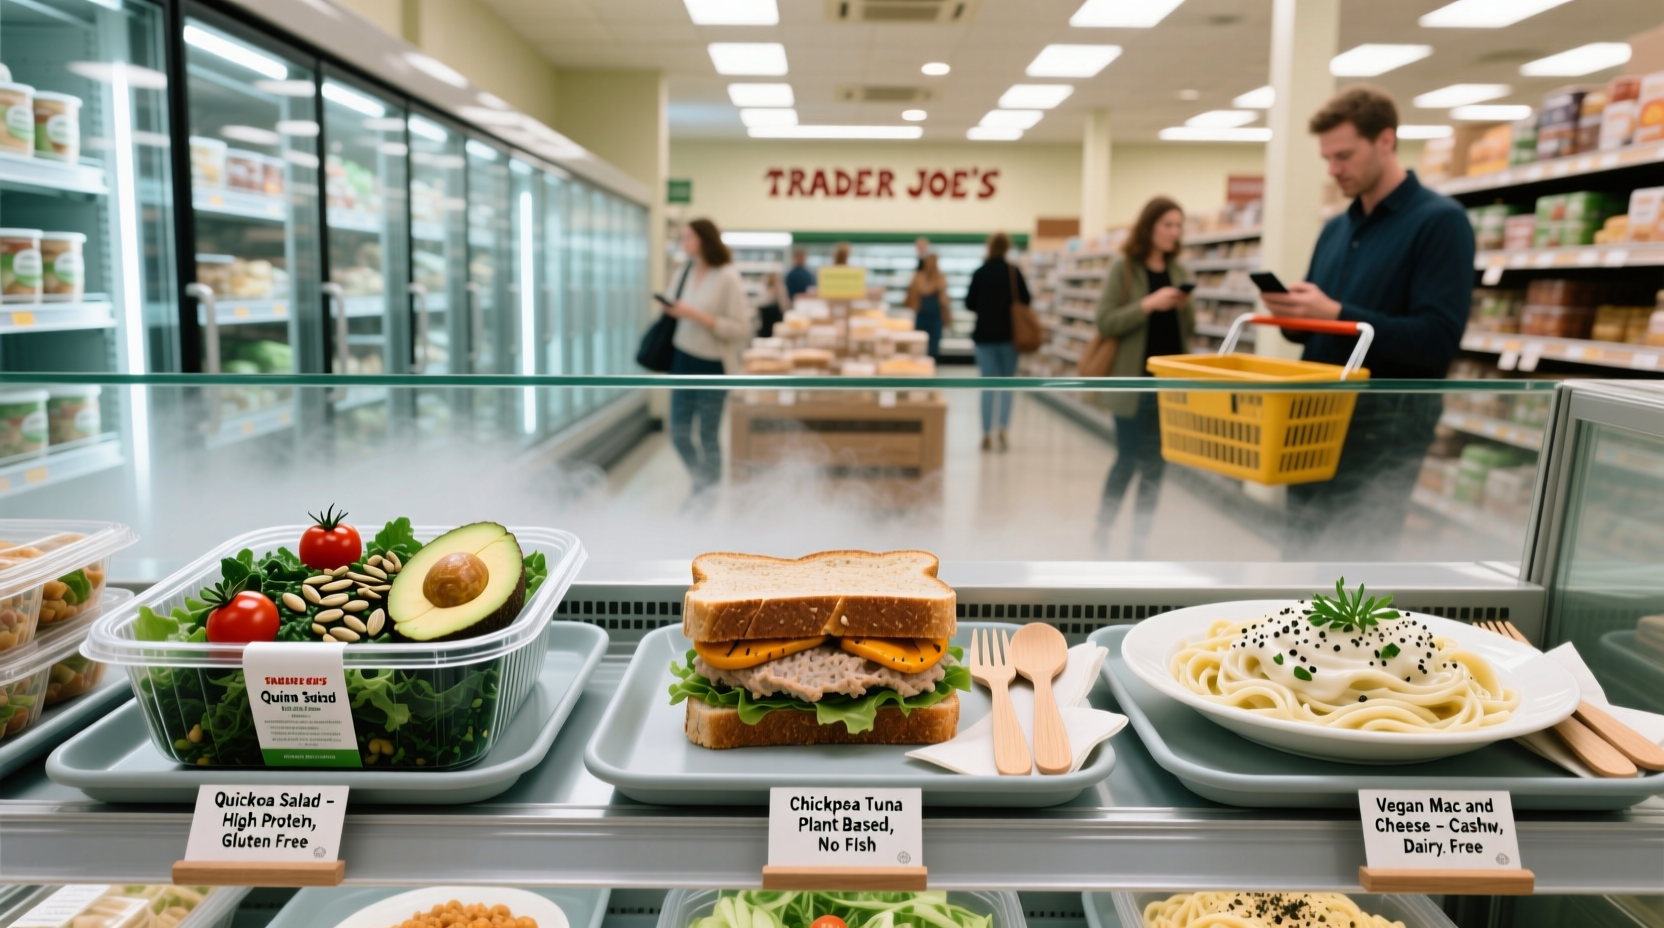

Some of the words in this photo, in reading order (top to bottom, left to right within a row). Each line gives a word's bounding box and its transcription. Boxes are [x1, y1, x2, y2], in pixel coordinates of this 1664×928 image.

[765, 169, 895, 198] TRADER
[907, 168, 1000, 199] JOE'S
[279, 792, 321, 808] Salad
[864, 796, 903, 812] Tuna
[1376, 797, 1424, 816] Vegan
[1429, 797, 1462, 813] Mac
[1465, 798, 1494, 813] and
[798, 816, 839, 832] Plant
[842, 816, 894, 835] Based,
[1375, 817, 1431, 833] Cheese
[222, 832, 271, 848] Gluten
[275, 834, 309, 848] Free
[818, 837, 840, 852] No
[1450, 838, 1484, 854] Free
